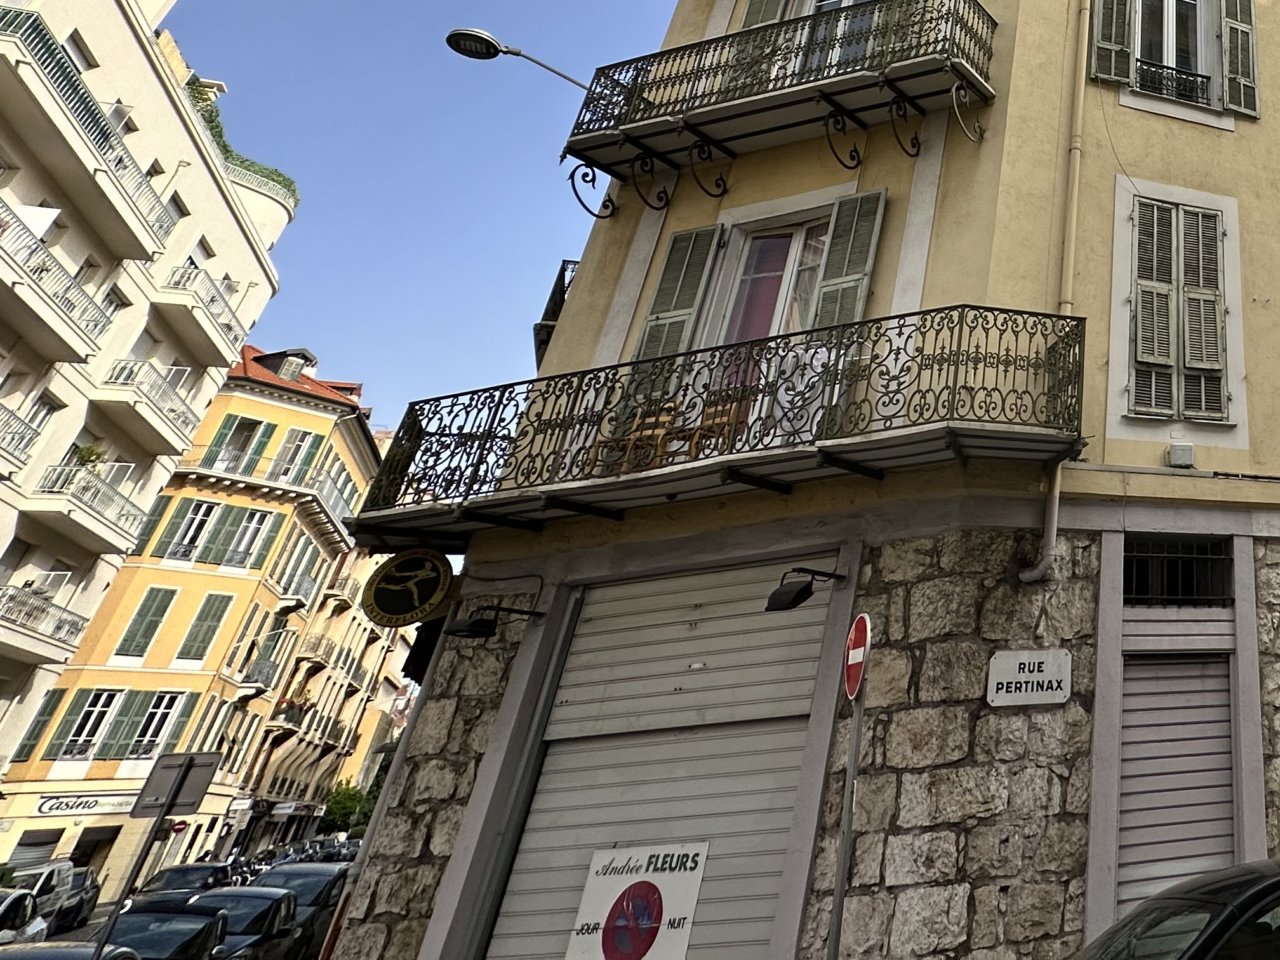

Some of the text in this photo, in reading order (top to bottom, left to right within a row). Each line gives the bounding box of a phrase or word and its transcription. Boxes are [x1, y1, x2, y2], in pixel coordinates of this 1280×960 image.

[366, 602, 434, 624] INTERFLORA
[1018, 661, 1045, 674] RUE
[995, 679, 1063, 694] PERTINAX
[38, 796, 98, 814] Casino
[595, 852, 700, 876] Andrée FLEURS
[576, 917, 687, 935] JOUR NUIT
